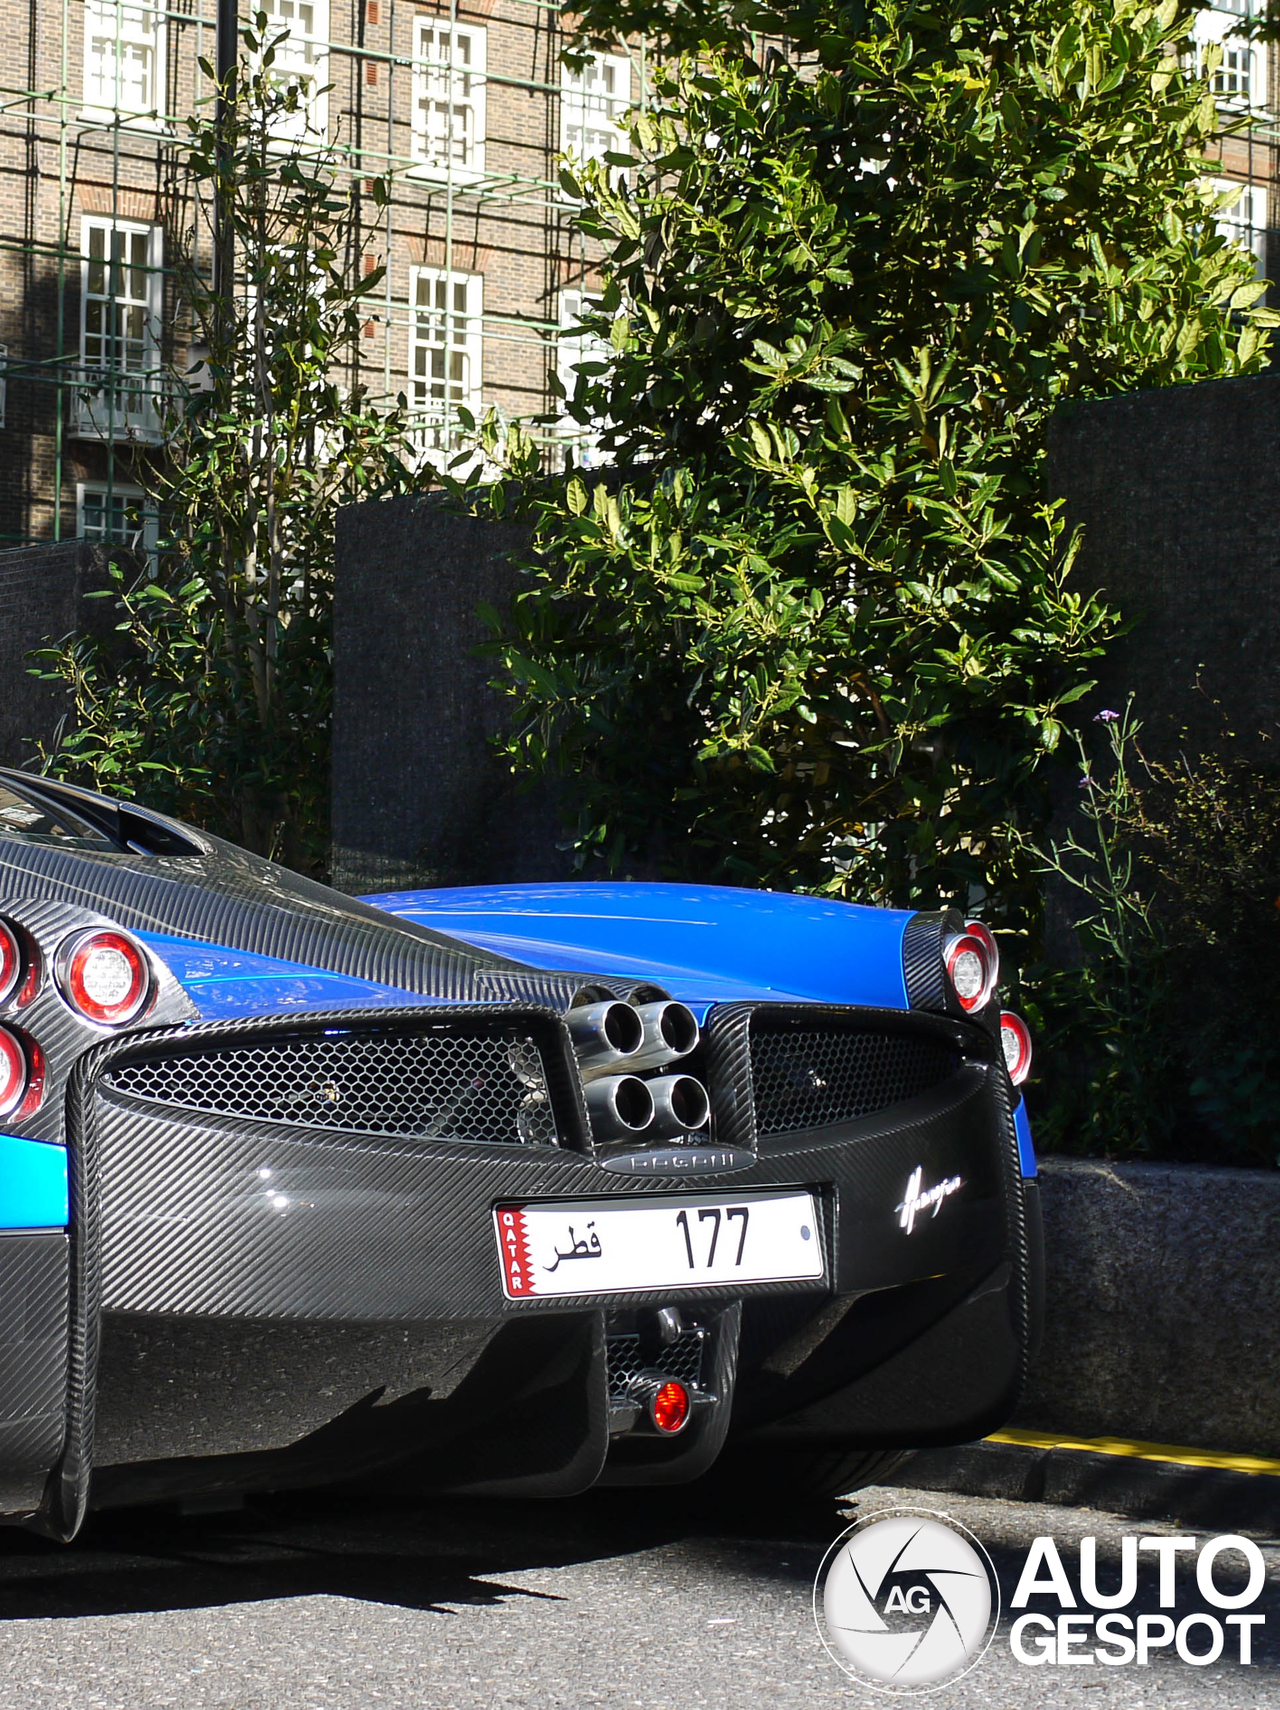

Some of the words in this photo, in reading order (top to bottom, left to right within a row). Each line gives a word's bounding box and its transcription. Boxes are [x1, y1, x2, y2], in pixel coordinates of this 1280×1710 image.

[502, 1212, 523, 1290] QATAR
[542, 1220, 603, 1273] قطر
[676, 1206, 750, 1270] 177
